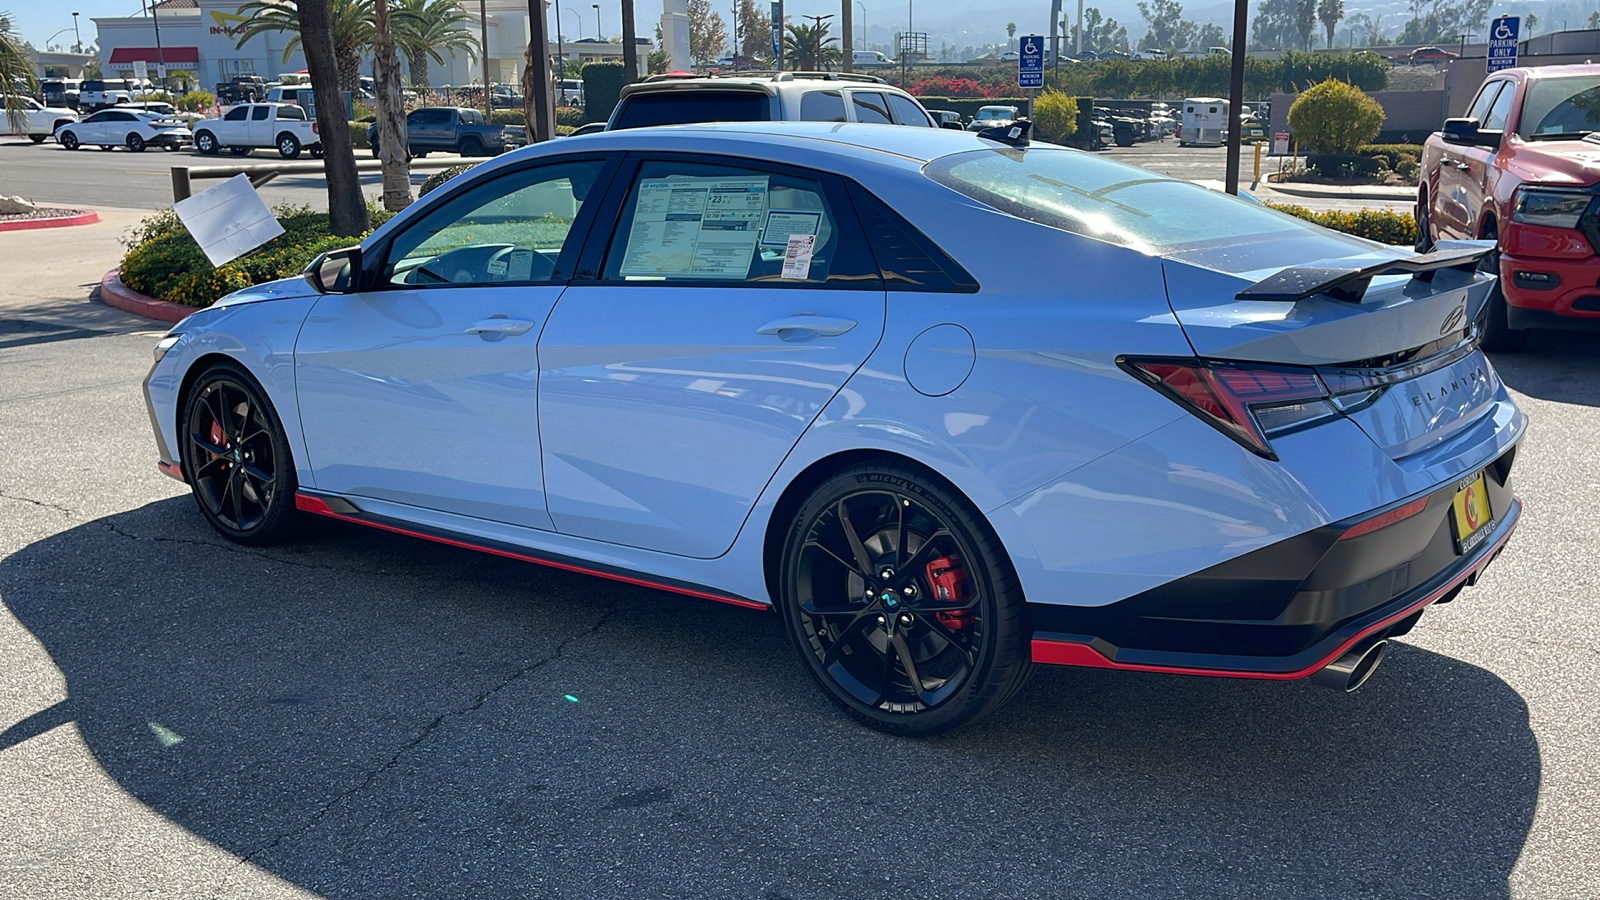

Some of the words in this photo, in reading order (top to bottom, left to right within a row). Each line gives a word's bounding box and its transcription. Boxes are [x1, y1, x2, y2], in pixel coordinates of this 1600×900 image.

[1490, 39, 1517, 48] PARKING
[1494, 49, 1512, 57] ONLY
[712, 195, 723, 204] 23
[1412, 368, 1484, 406] ELANTRA
[870, 474, 923, 494] MICHELIN
[1464, 486, 1479, 531] C
